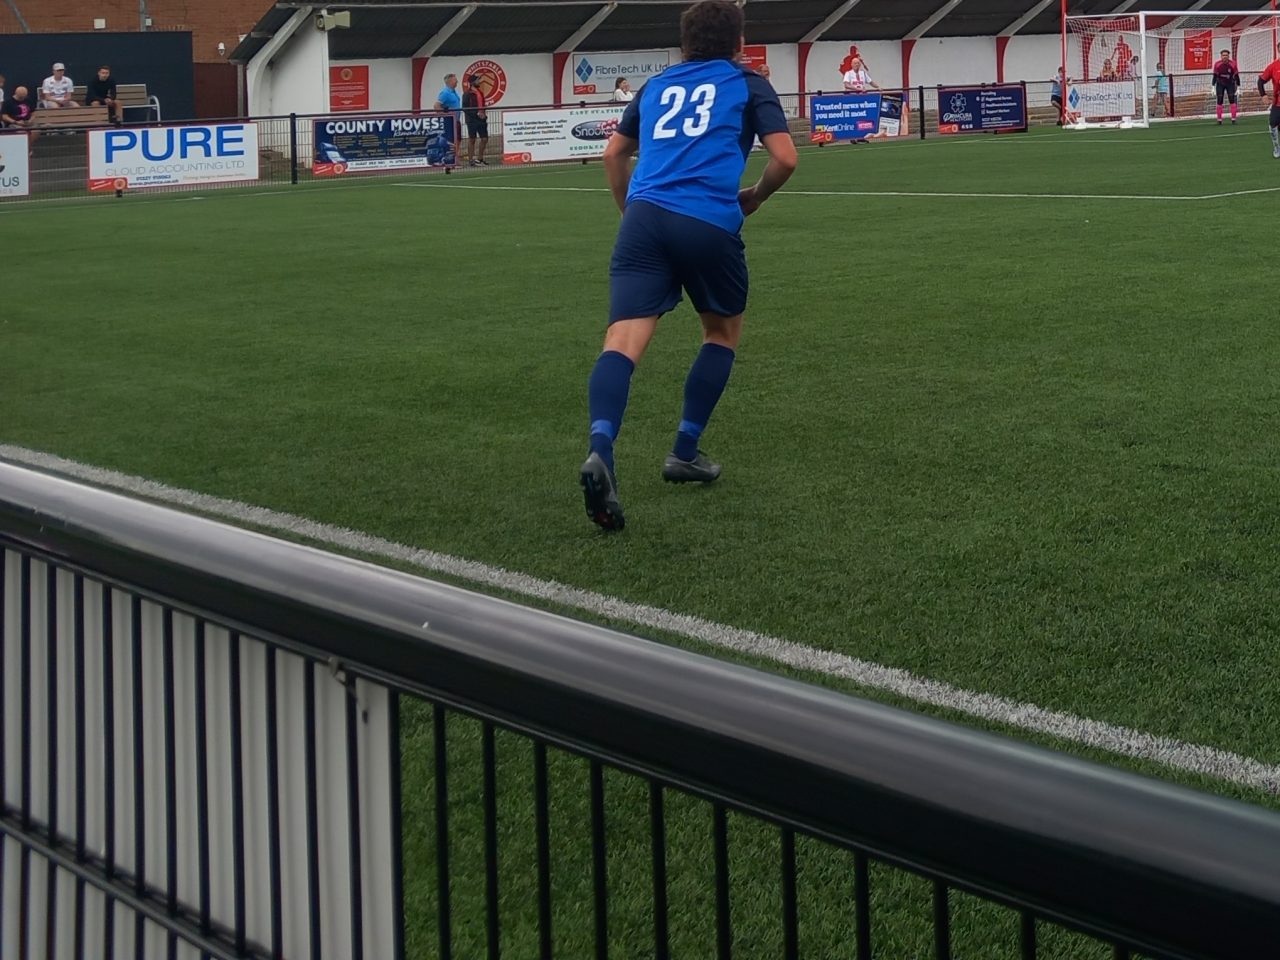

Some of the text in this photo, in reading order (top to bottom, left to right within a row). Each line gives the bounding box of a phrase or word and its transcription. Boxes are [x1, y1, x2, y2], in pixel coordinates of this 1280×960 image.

[466, 61, 503, 75] WHITSTABLE
[595, 63, 639, 75] FibreTech
[641, 64, 653, 73] UK
[653, 83, 716, 140] 23
[815, 102, 841, 111] Trusted
[859, 101, 877, 109] when
[828, 110, 844, 118] need
[326, 120, 385, 134] COUNTY
[391, 117, 440, 132] MOVES
[575, 126, 614, 137] Snooke
[823, 123, 854, 132] KentOnline
[105, 125, 244, 164] PURE
[105, 166, 146, 177] CLOUD
[150, 161, 223, 174] ACCOUNTING
[226, 160, 245, 169] LTD
[0, 177, 20, 187] US
